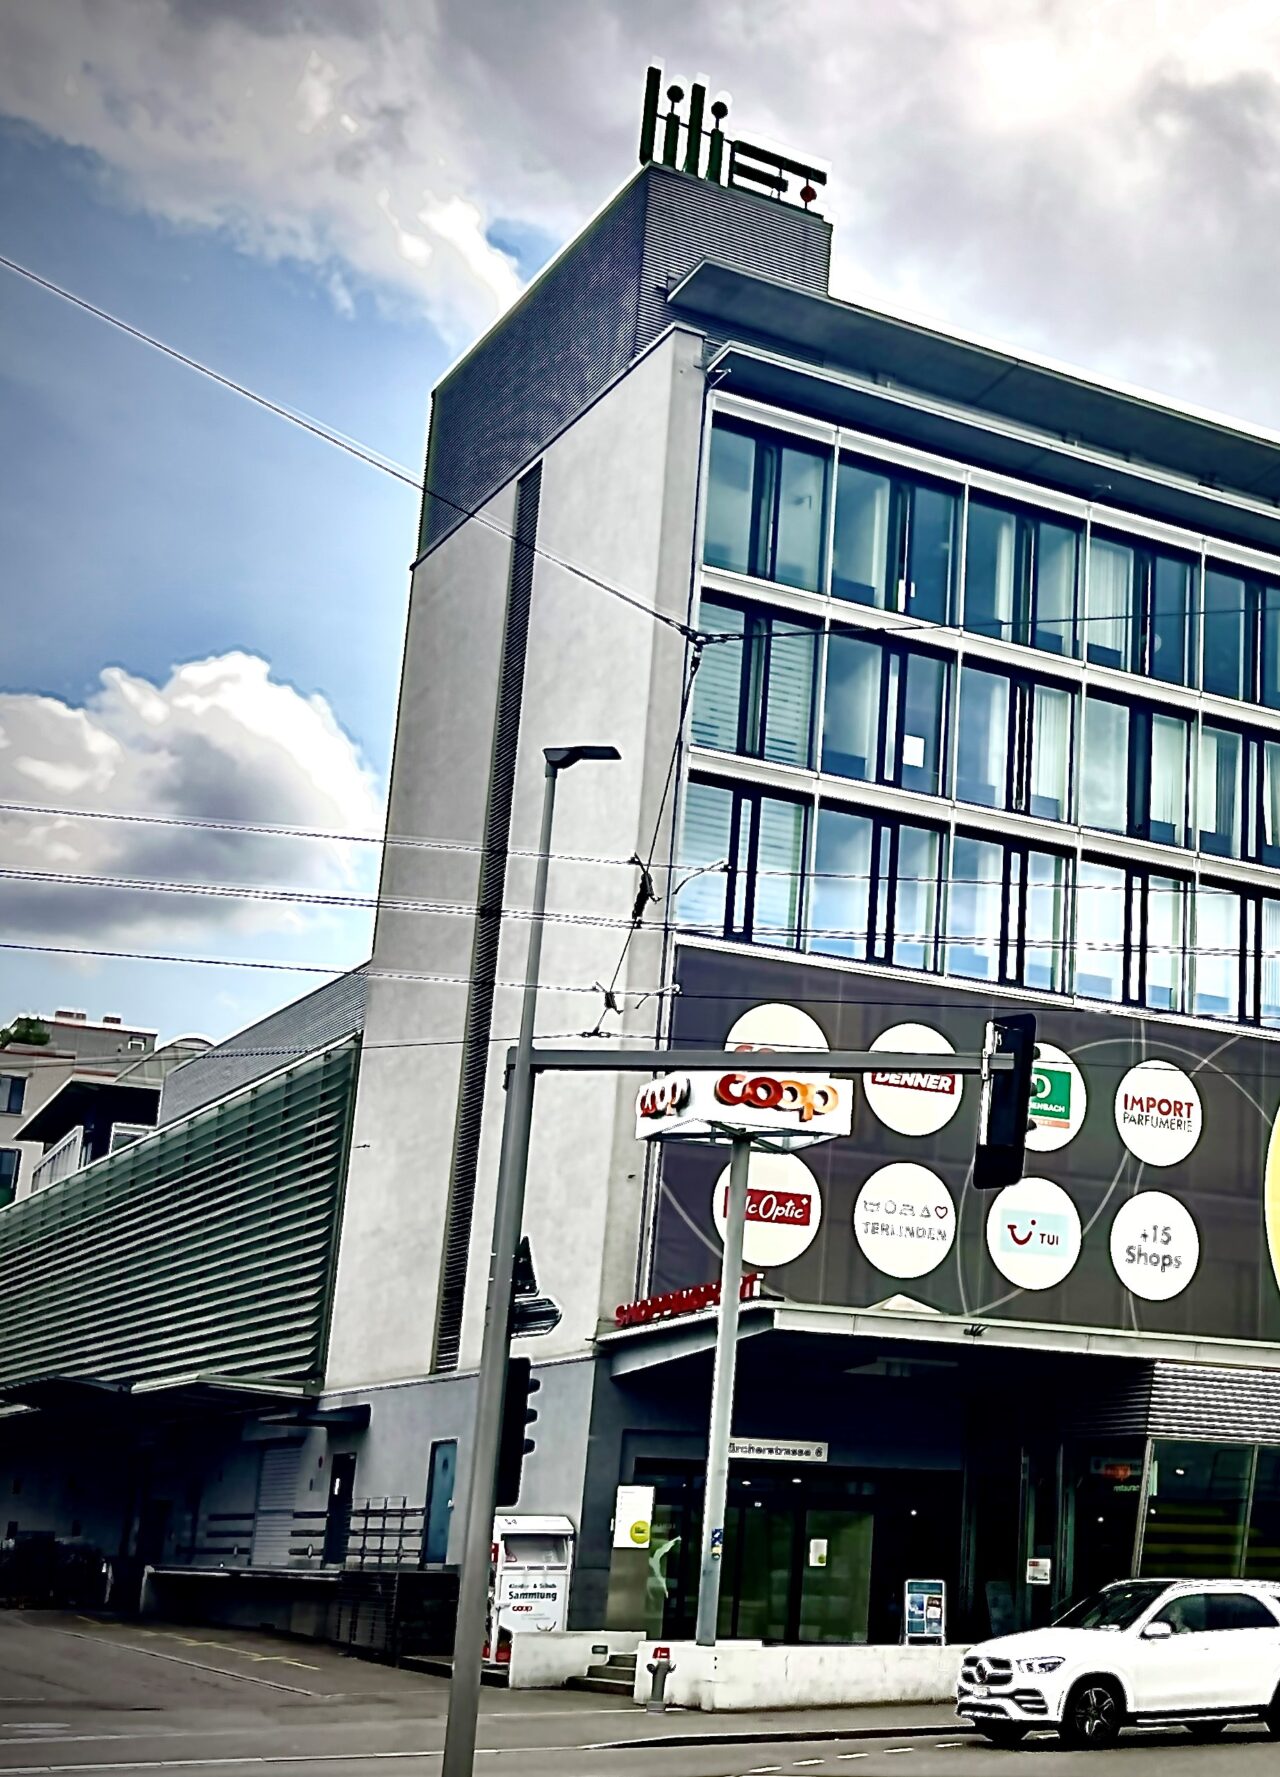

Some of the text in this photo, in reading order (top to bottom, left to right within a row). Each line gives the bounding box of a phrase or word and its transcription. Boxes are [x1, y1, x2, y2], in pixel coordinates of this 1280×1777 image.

[875, 1072, 952, 1092] DENNER
[1123, 1093, 1194, 1119] IMPORT
[1122, 1111, 1193, 1133] PARFUMERIE
[1039, 1233, 1060, 1246] TUI
[1140, 1225, 1172, 1246] +15
[1125, 1245, 1182, 1273] Shops
[728, 1443, 811, 1457] ürcherstrasse
[509, 1591, 557, 1602] Sammlung
